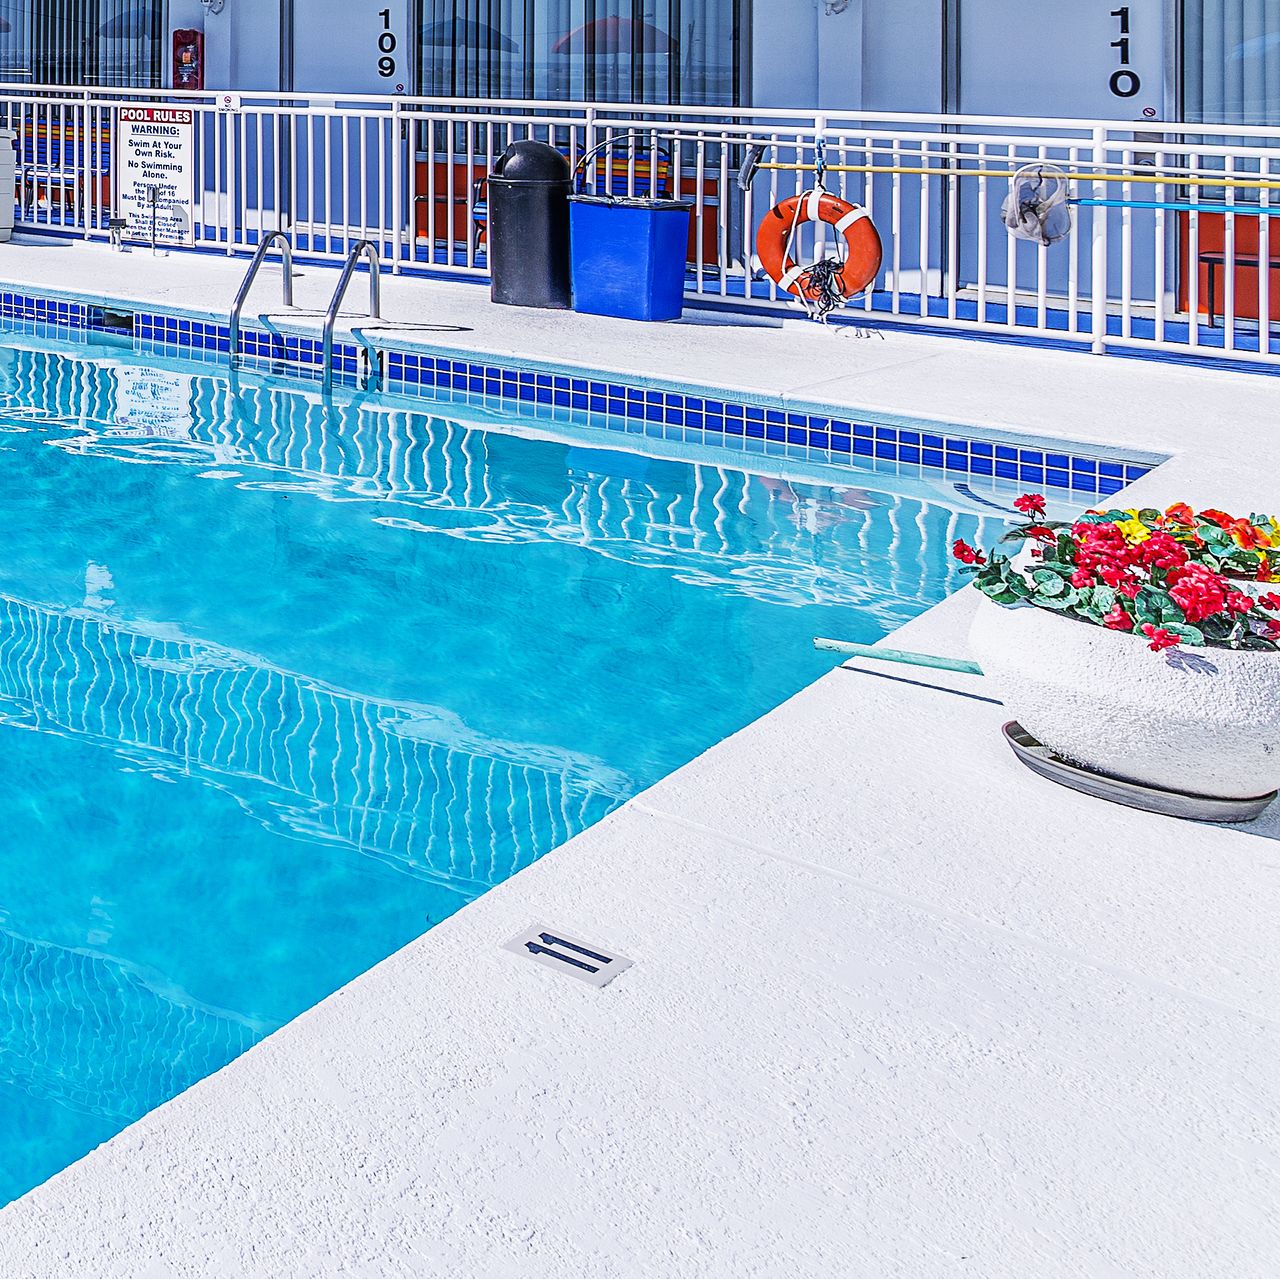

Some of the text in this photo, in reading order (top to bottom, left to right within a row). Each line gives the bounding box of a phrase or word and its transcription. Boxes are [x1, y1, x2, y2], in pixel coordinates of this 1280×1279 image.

[378, 8, 397, 77] 109
[1109, 6, 1141, 98] 110
[121, 109, 191, 122] POOL RULES
[131, 124, 180, 135] WARNING:
[128, 139, 150, 148] Swim
[164, 141, 182, 150] Your
[135, 149, 175, 159] Own Risk.
[128, 160, 183, 173] No Swimming
[142, 170, 168, 179] Alone.
